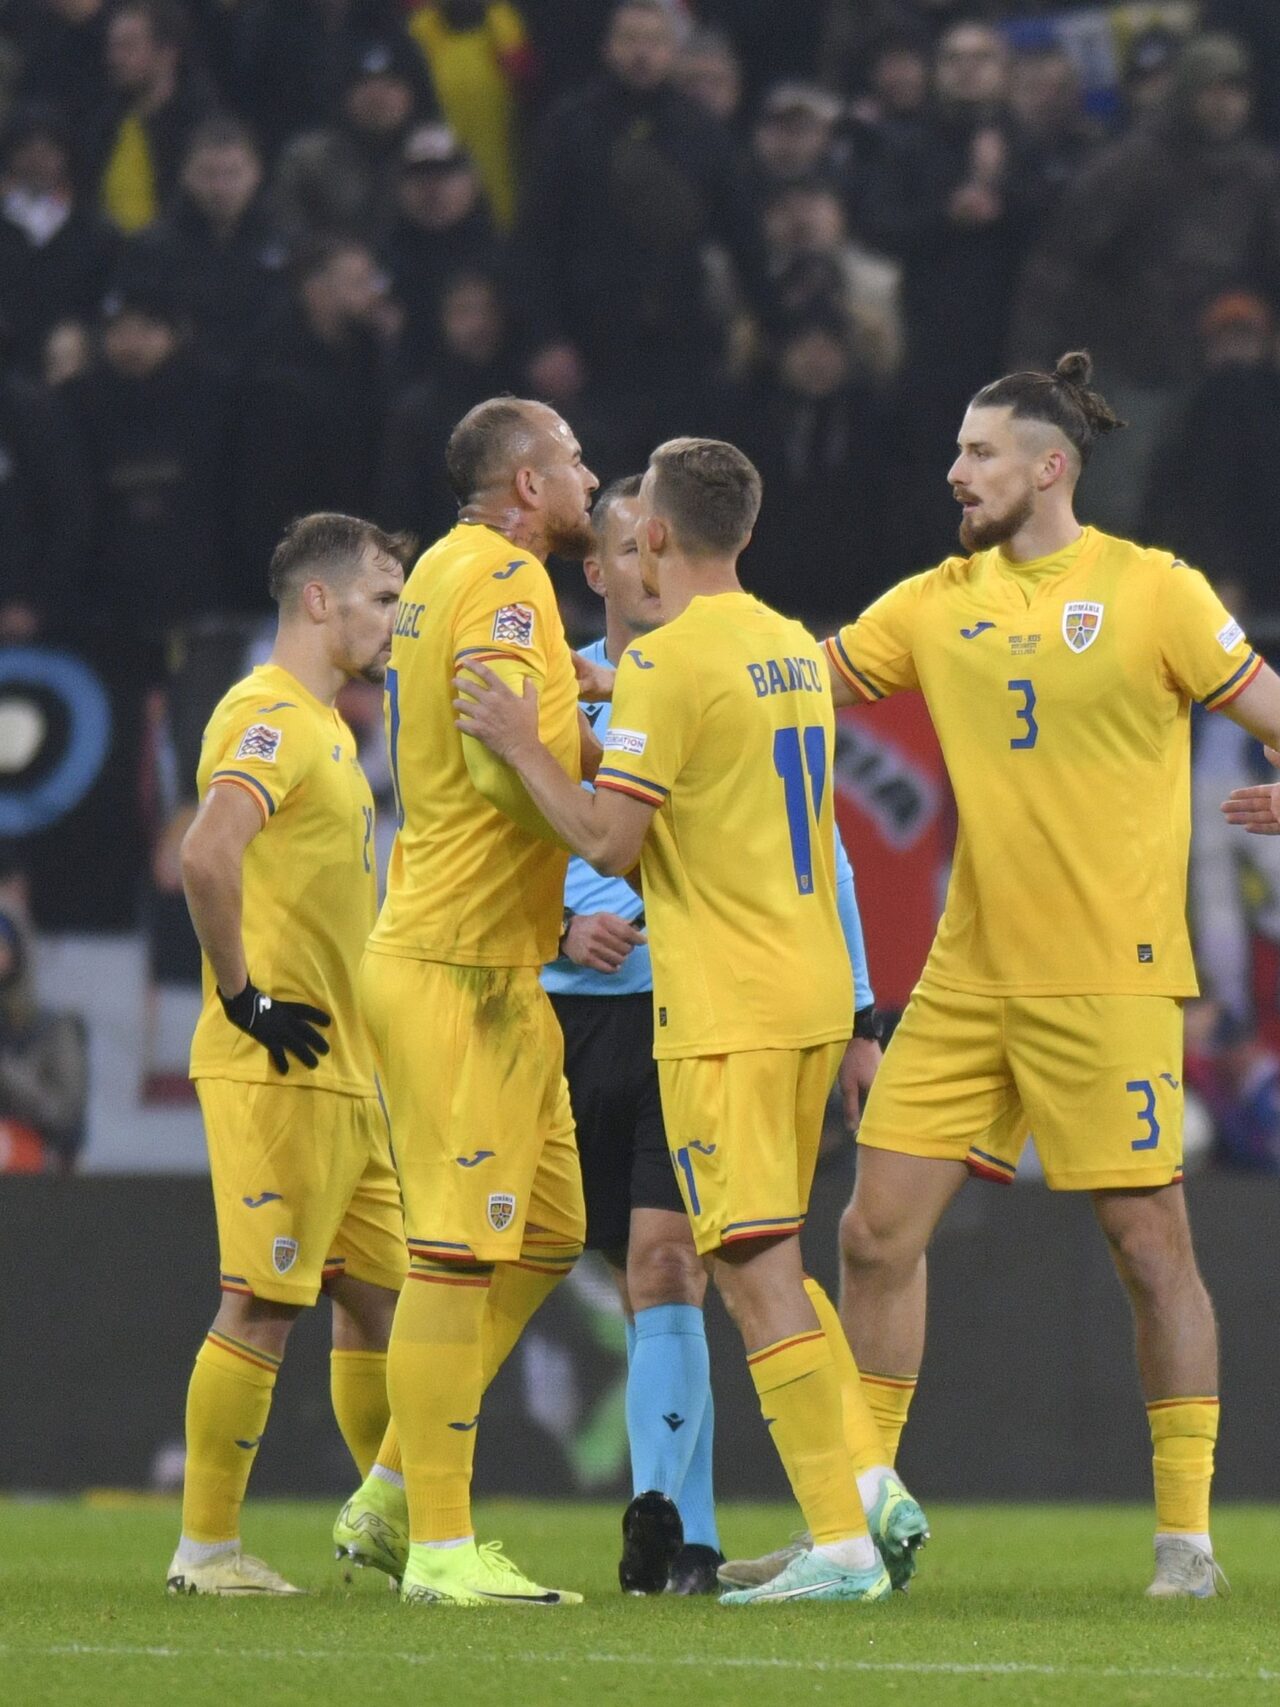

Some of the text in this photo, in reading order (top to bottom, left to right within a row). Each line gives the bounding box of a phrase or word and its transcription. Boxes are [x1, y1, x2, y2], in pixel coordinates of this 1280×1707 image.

[747, 657, 822, 698] BANCU
[1008, 680, 1038, 750] 3
[773, 726, 826, 895] 11
[1126, 1080, 1160, 1152] 3
